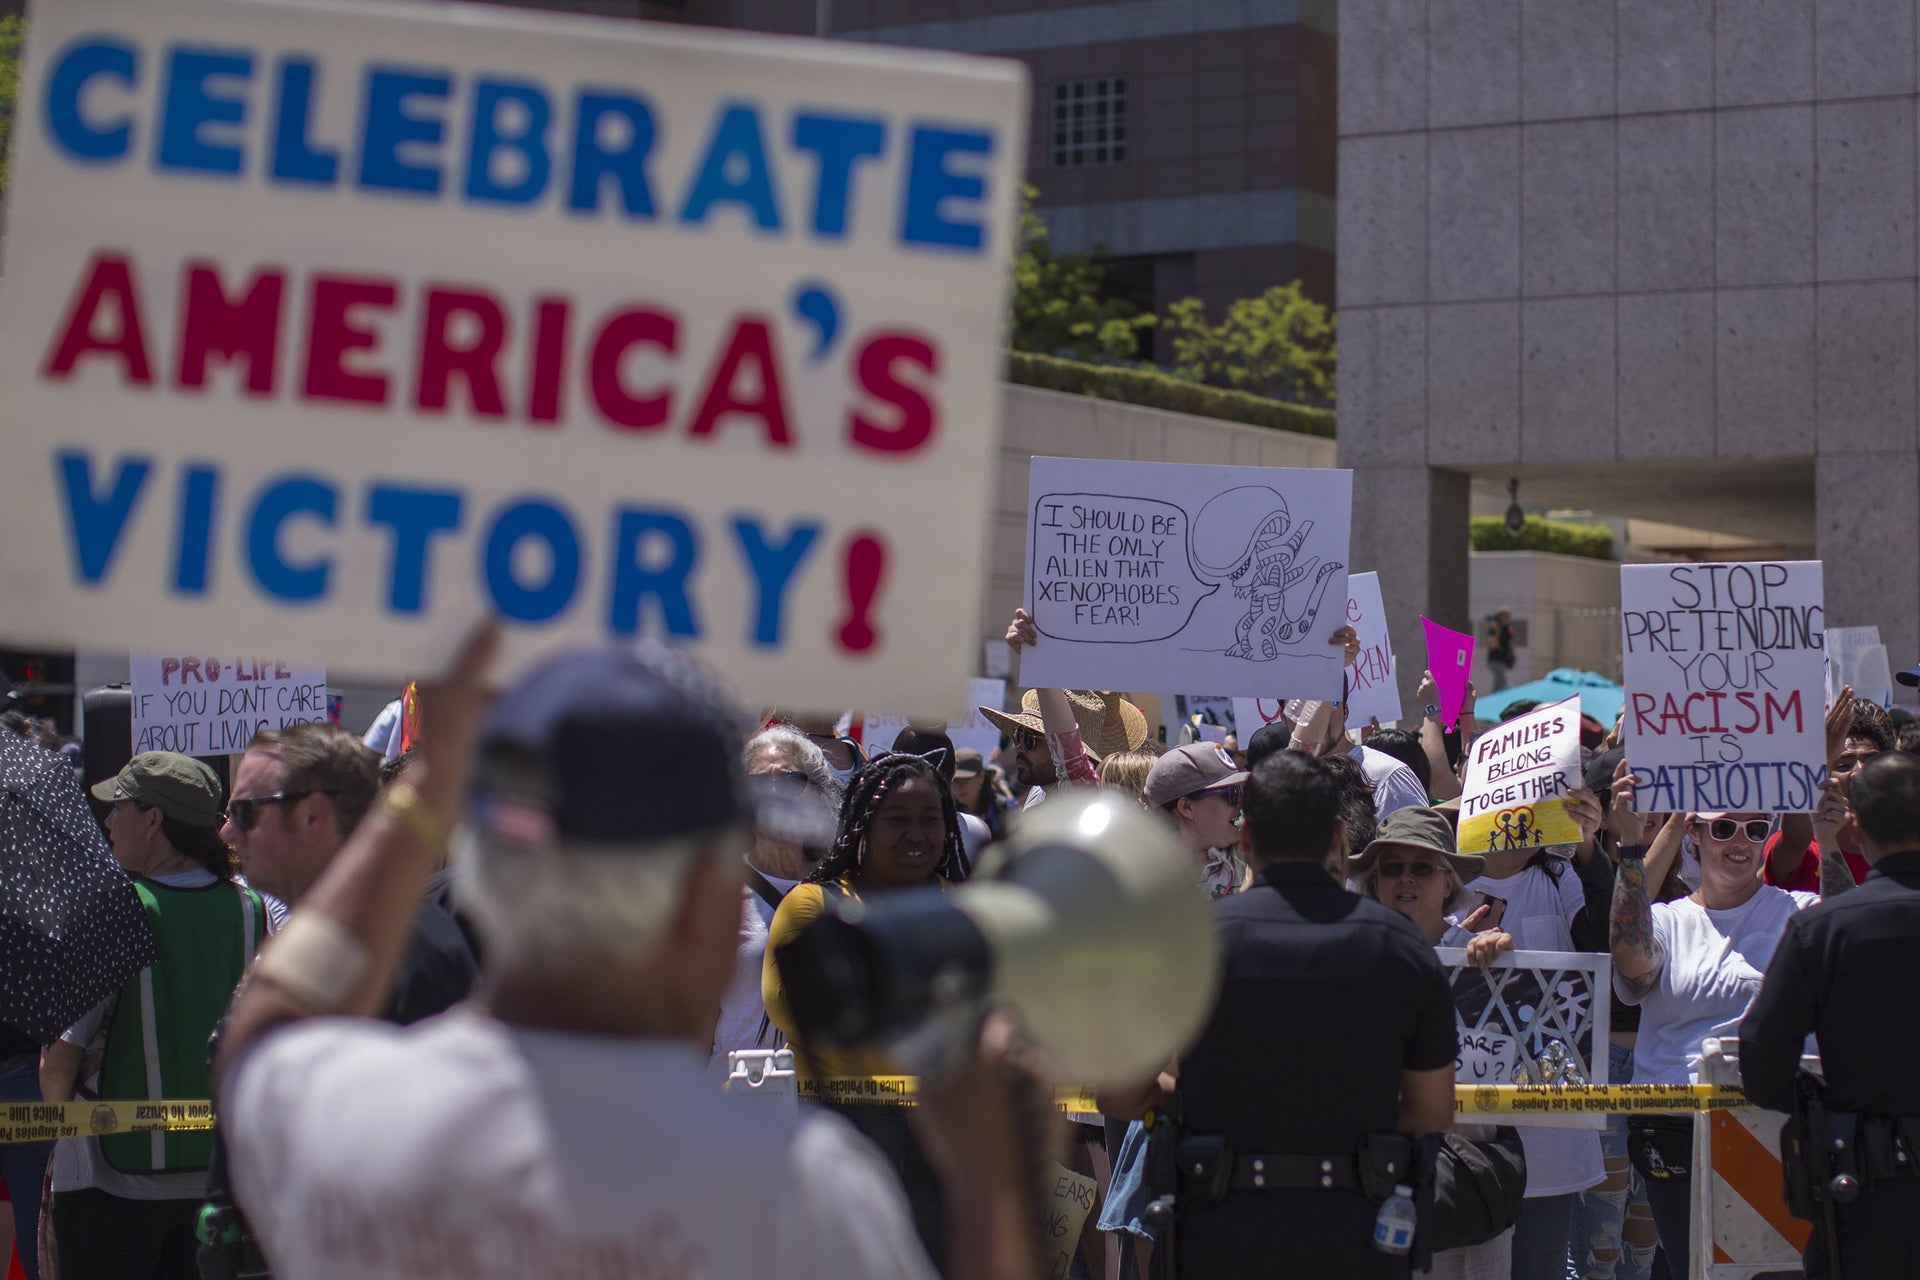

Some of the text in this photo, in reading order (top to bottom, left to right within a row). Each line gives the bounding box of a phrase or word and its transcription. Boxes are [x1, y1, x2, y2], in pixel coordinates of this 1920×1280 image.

[39, 30, 998, 256] CELEBRATE
[40, 247, 945, 459] AMERICA'S
[1041, 505, 1178, 536] I SHOULD BE
[52, 445, 893, 660] VICTORY!
[1056, 533, 1165, 559] THE ONLY
[1046, 555, 1165, 578] ALIEN THAT
[1038, 581, 1180, 606] XENOPHOBES
[1669, 564, 1788, 609] STOP
[1074, 604, 1141, 627] FEAR!
[1623, 605, 1824, 652] PRETENDING
[1668, 651, 1779, 691] YOUR
[134, 694, 154, 719] IF
[163, 690, 208, 717] YOU
[276, 684, 326, 712] CARE
[1632, 689, 1804, 736] RACISM
[134, 722, 200, 755] ABOUT
[1688, 733, 1744, 764] IS
[1487, 746, 1552, 781] BELONG
[1464, 771, 1571, 816] TOGETHER
[1629, 761, 1828, 812] PATRIOTISM
[864, 1081, 877, 1095] De
[9, 1106, 65, 1123] Police Line
[136, 1105, 167, 1121] Cruzar
[171, 1106, 186, 1122] No
[1512, 1097, 1700, 1112] Departamento De Policia De Los Angeles
[16, 1126, 58, 1139] Angeles
[60, 1126, 78, 1136] Los
